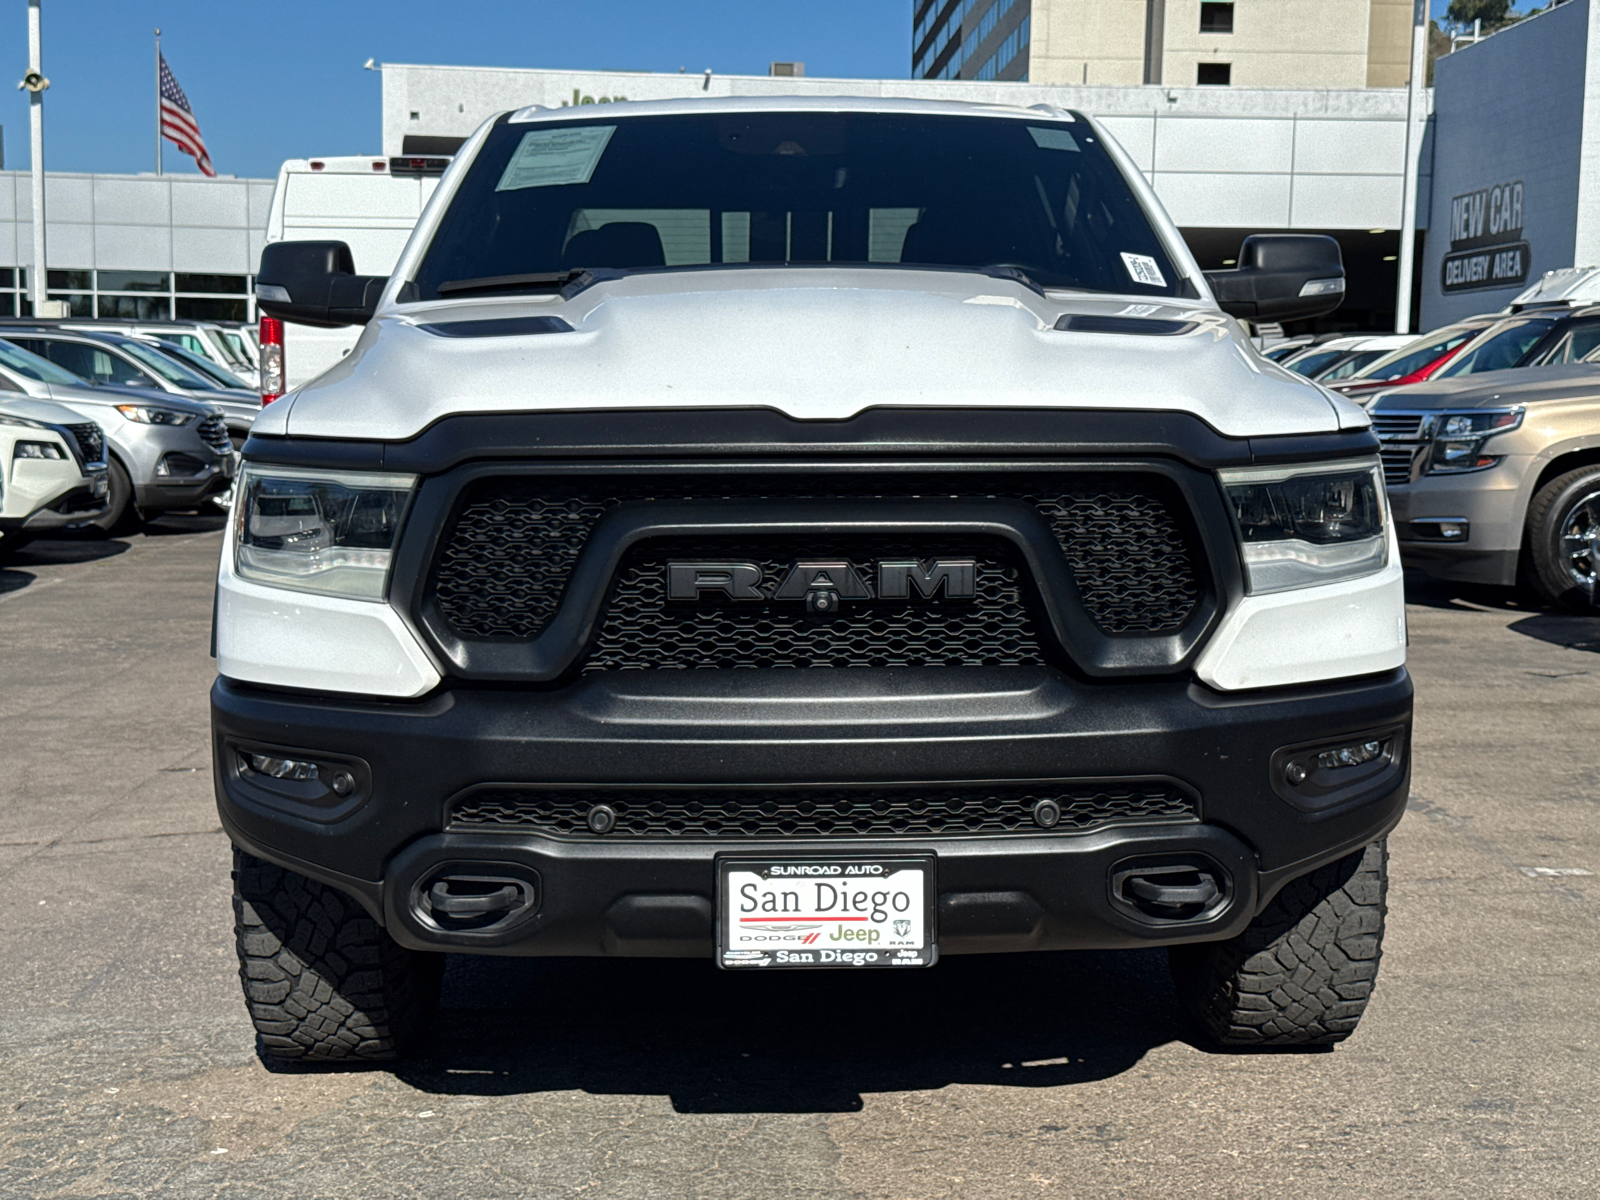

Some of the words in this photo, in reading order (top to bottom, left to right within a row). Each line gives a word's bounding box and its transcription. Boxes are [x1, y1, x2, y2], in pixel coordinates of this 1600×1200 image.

[562, 89, 628, 107] Jee
[1451, 191, 1487, 242] NEW
[1489, 182, 1523, 236] CAR
[1445, 255, 1491, 286] DELIVERY
[1492, 250, 1522, 280] AREA
[667, 559, 977, 600] RAM
[770, 866, 842, 876] SUNROAD
[845, 865, 883, 875] AUTO
[740, 882, 801, 913] San
[814, 881, 910, 923] Diego
[829, 924, 880, 945] Jeep
[776, 950, 814, 963] San
[820, 949, 878, 966] Diego
